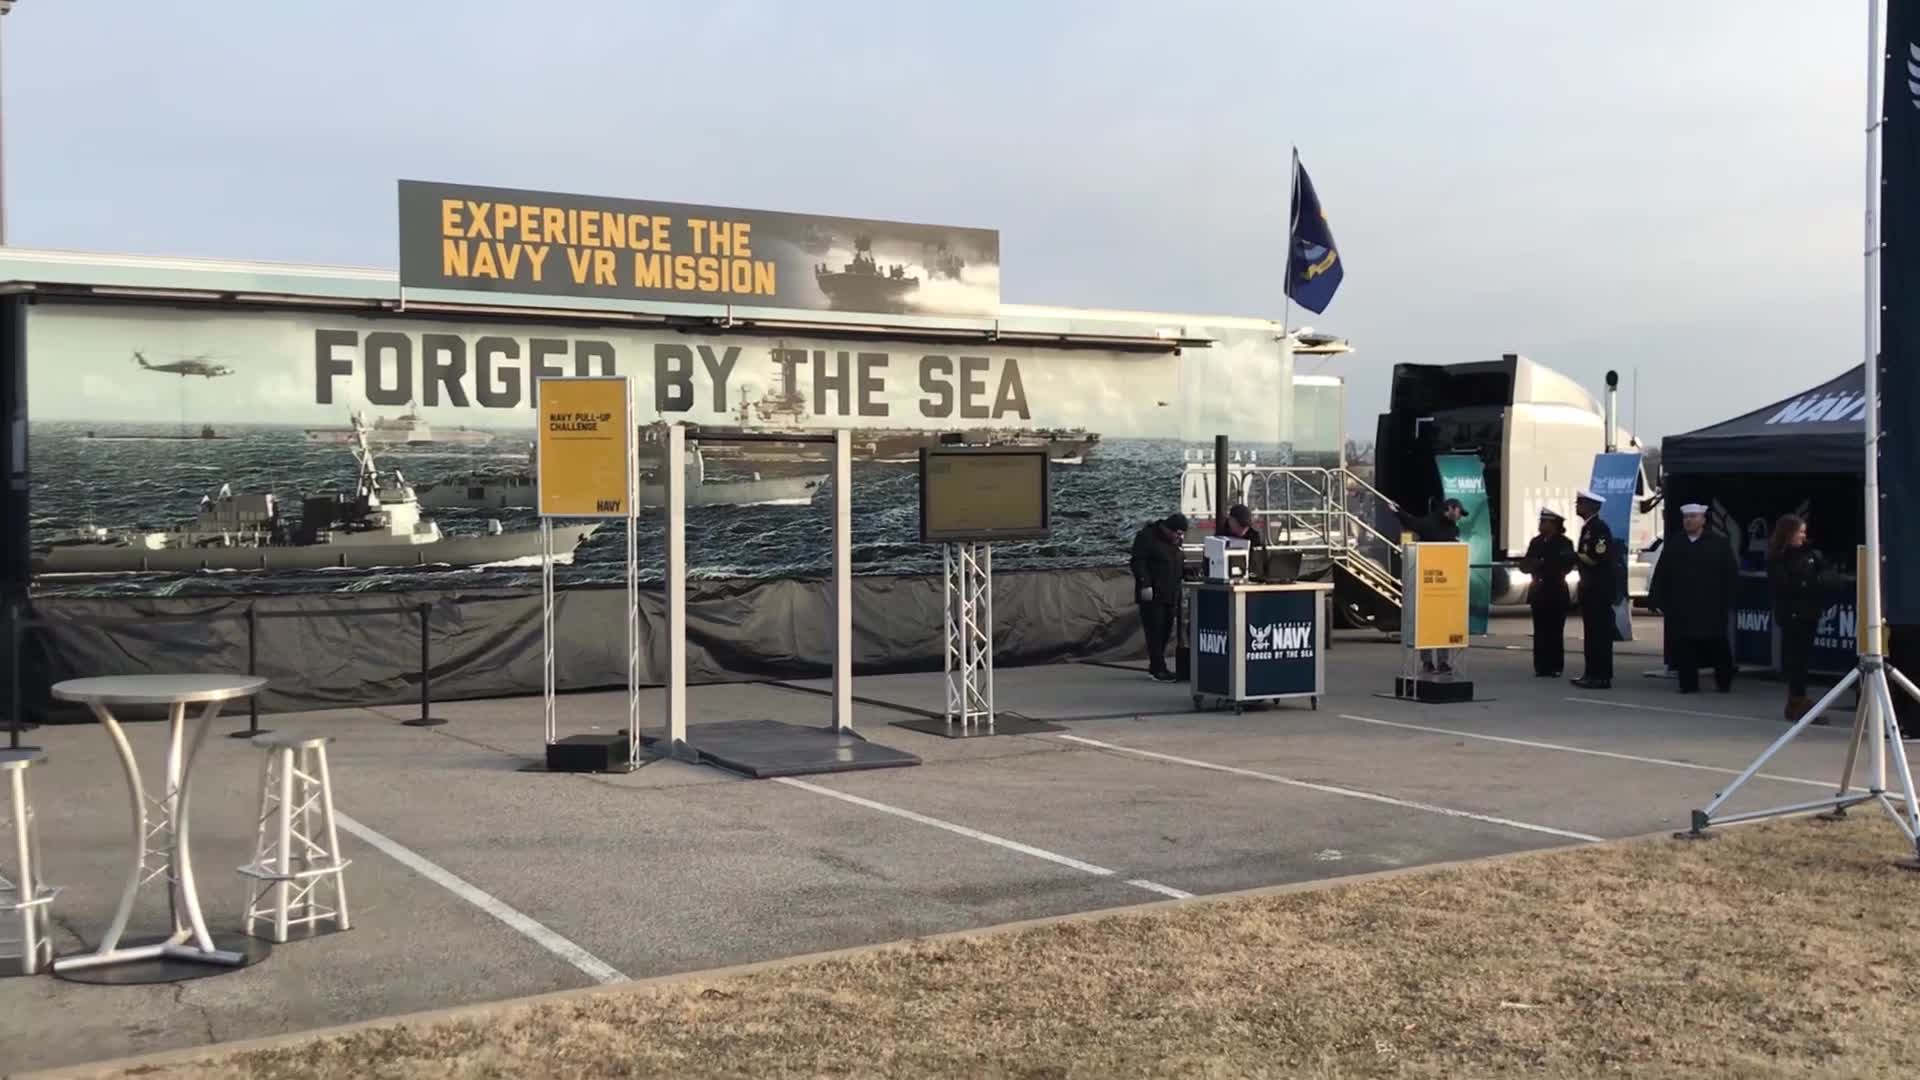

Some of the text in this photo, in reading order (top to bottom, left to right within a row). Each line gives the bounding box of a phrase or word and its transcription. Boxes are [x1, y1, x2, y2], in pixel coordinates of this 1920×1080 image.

[441, 199, 751, 257] EXPERIENCE THE
[442, 239, 776, 296] NAVY VR MISSION
[654, 343, 742, 413] BY
[771, 348, 889, 417] THE
[919, 355, 1031, 420] SEA
[550, 412, 612, 422] NAVY PULL-UP
[550, 422, 598, 432] CHALLENGE
[596, 501, 620, 512] NAVY
[1200, 633, 1227, 655] NAVY
[1273, 627, 1311, 650] NAVY
[1246, 649, 1314, 661] FORGED BY THE SEA
